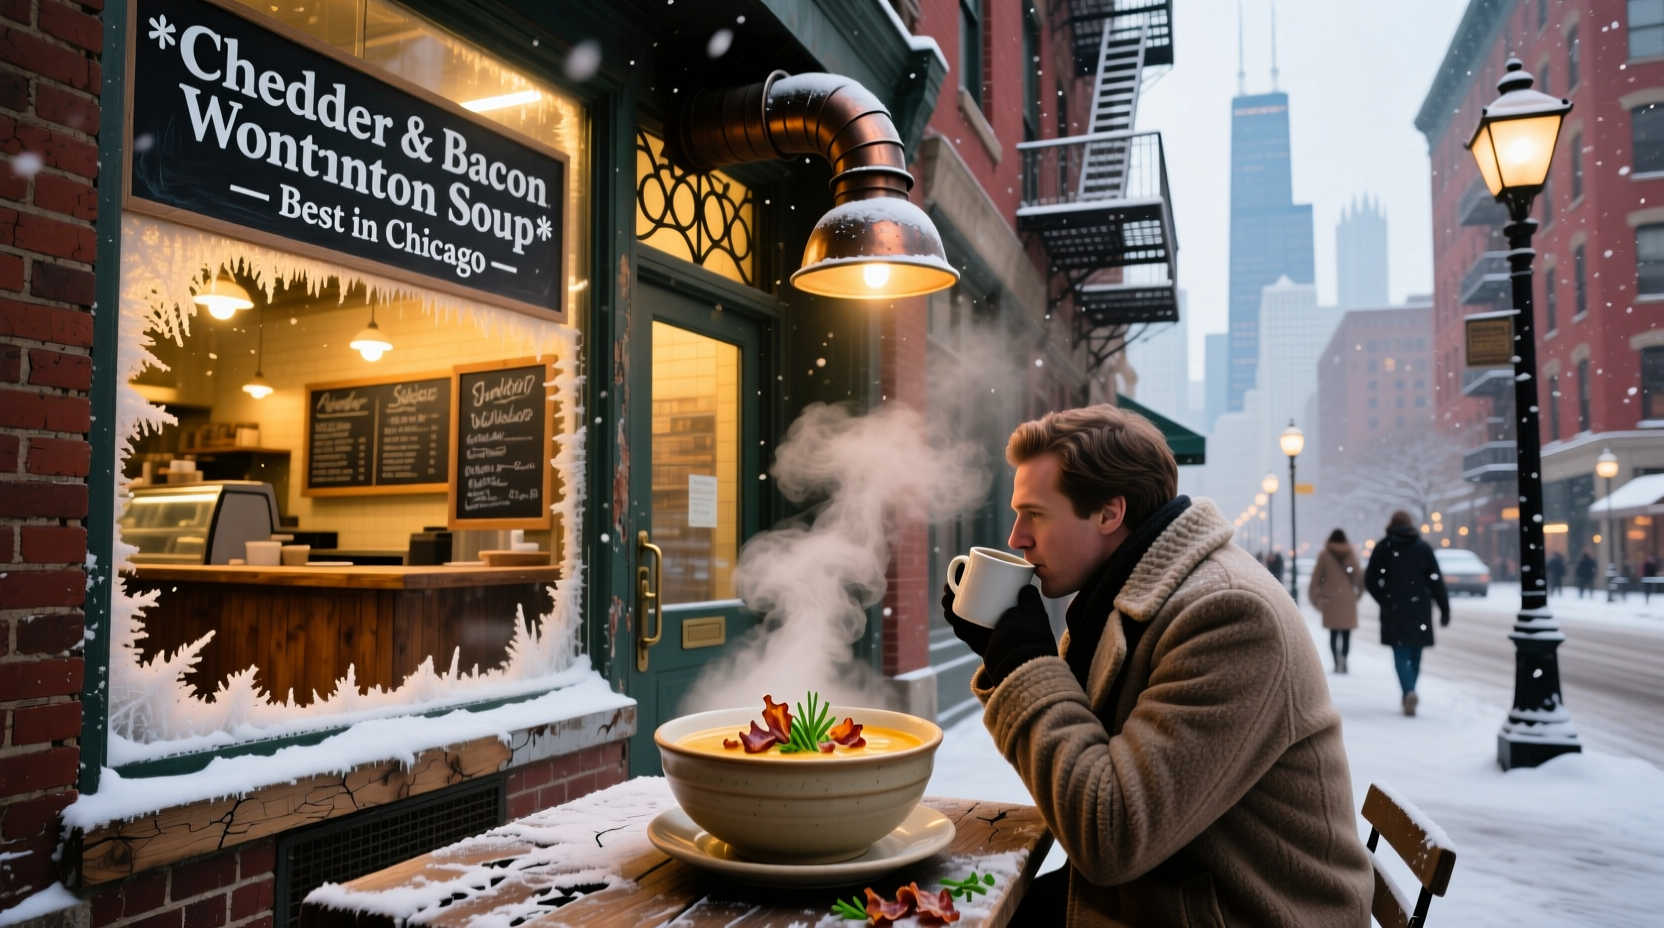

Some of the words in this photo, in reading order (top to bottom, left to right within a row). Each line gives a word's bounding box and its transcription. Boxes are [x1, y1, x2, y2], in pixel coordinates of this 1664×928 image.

[401, 116, 432, 162] &
[442, 128, 547, 207] Bacon
[279, 184, 344, 232] Best
[352, 207, 378, 242] in
[386, 219, 485, 277] Chicago
